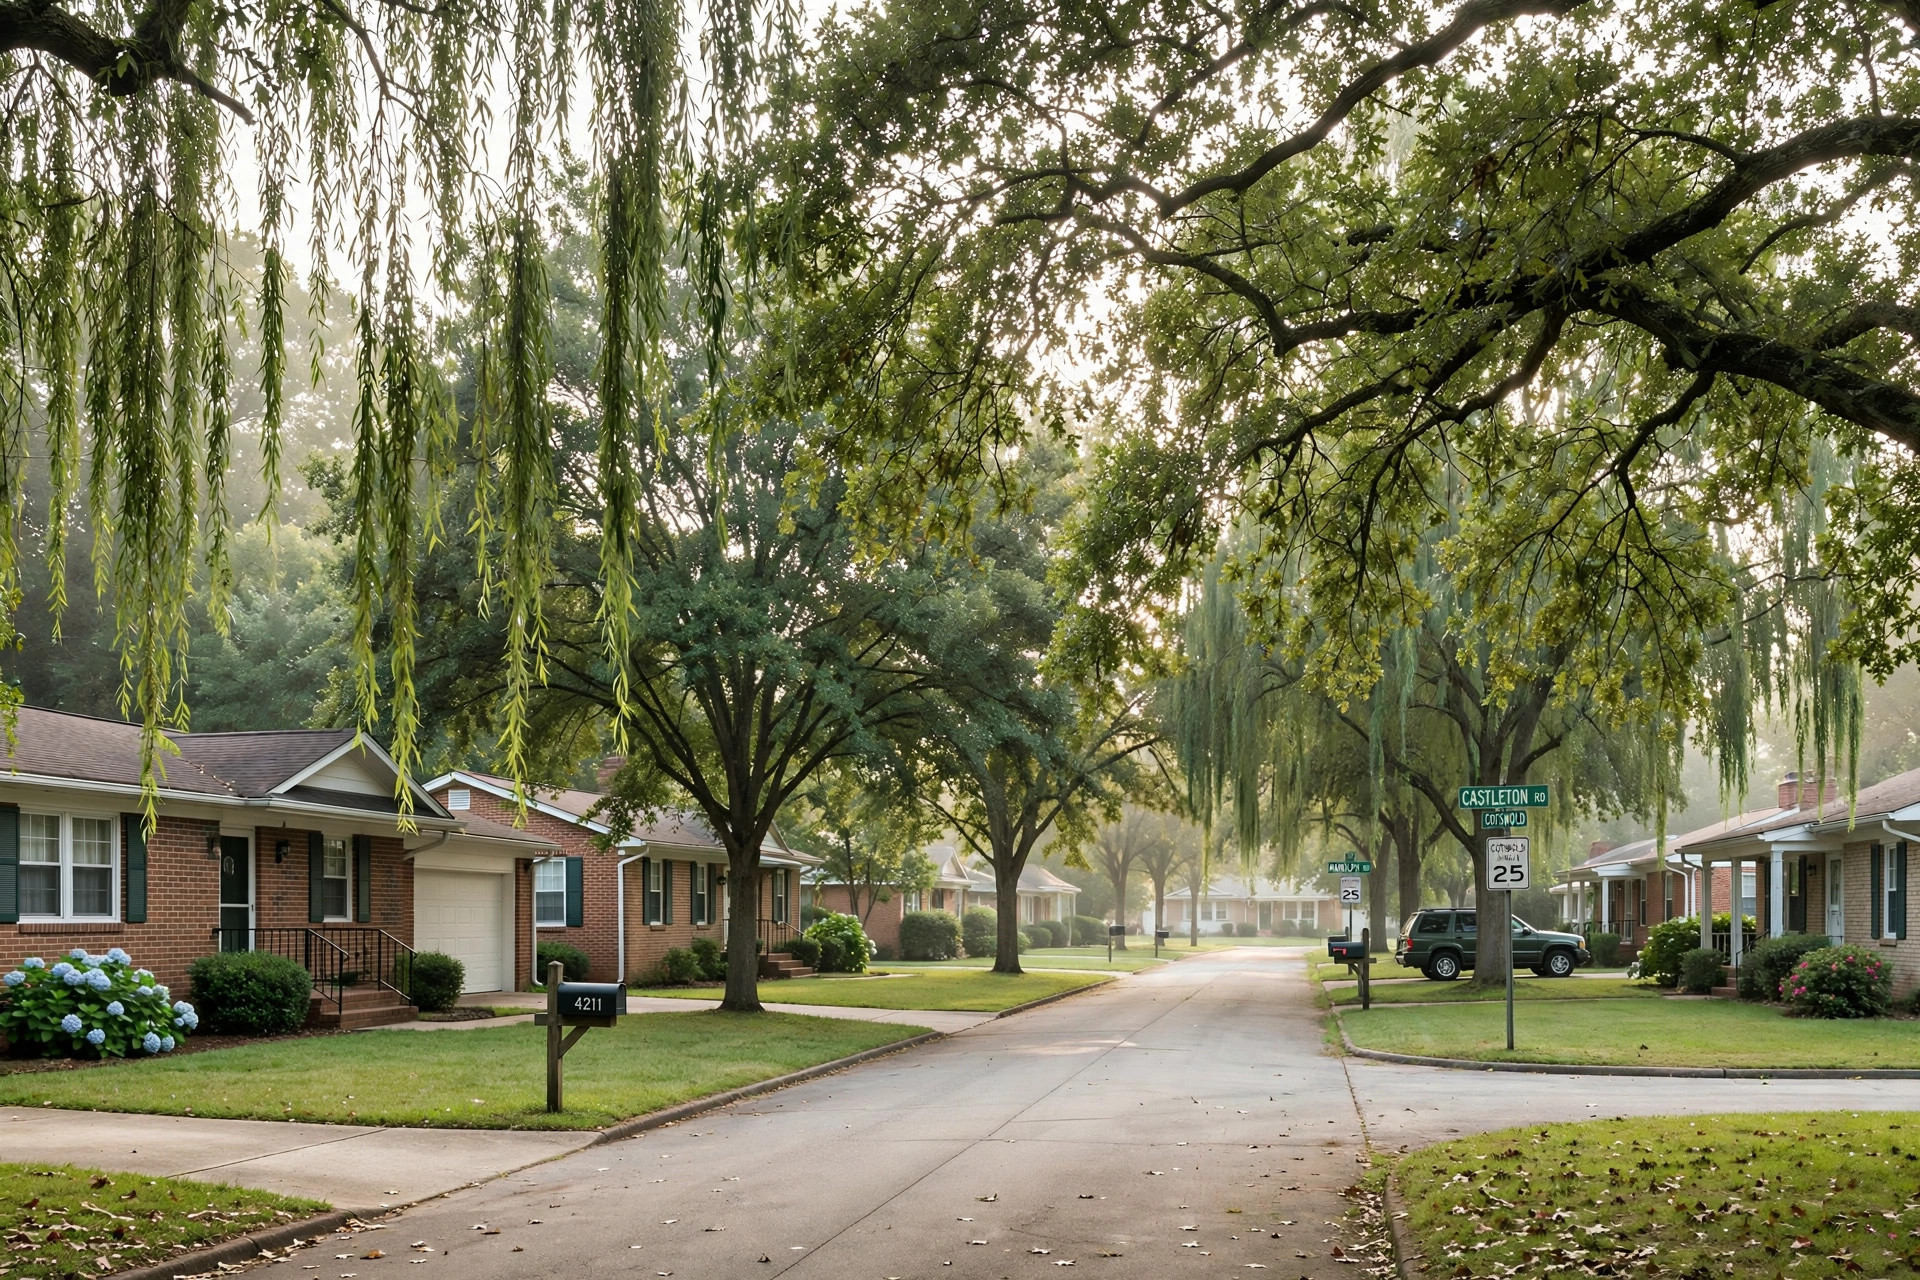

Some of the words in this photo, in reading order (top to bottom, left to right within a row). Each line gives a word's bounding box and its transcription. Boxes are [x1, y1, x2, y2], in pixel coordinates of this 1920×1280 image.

[1461, 788, 1529, 807] CASTLETON
[1534, 791, 1546, 803] RD
[1493, 864, 1525, 883] 25
[1342, 889, 1360, 901] 25
[574, 996, 602, 1011] 4211
